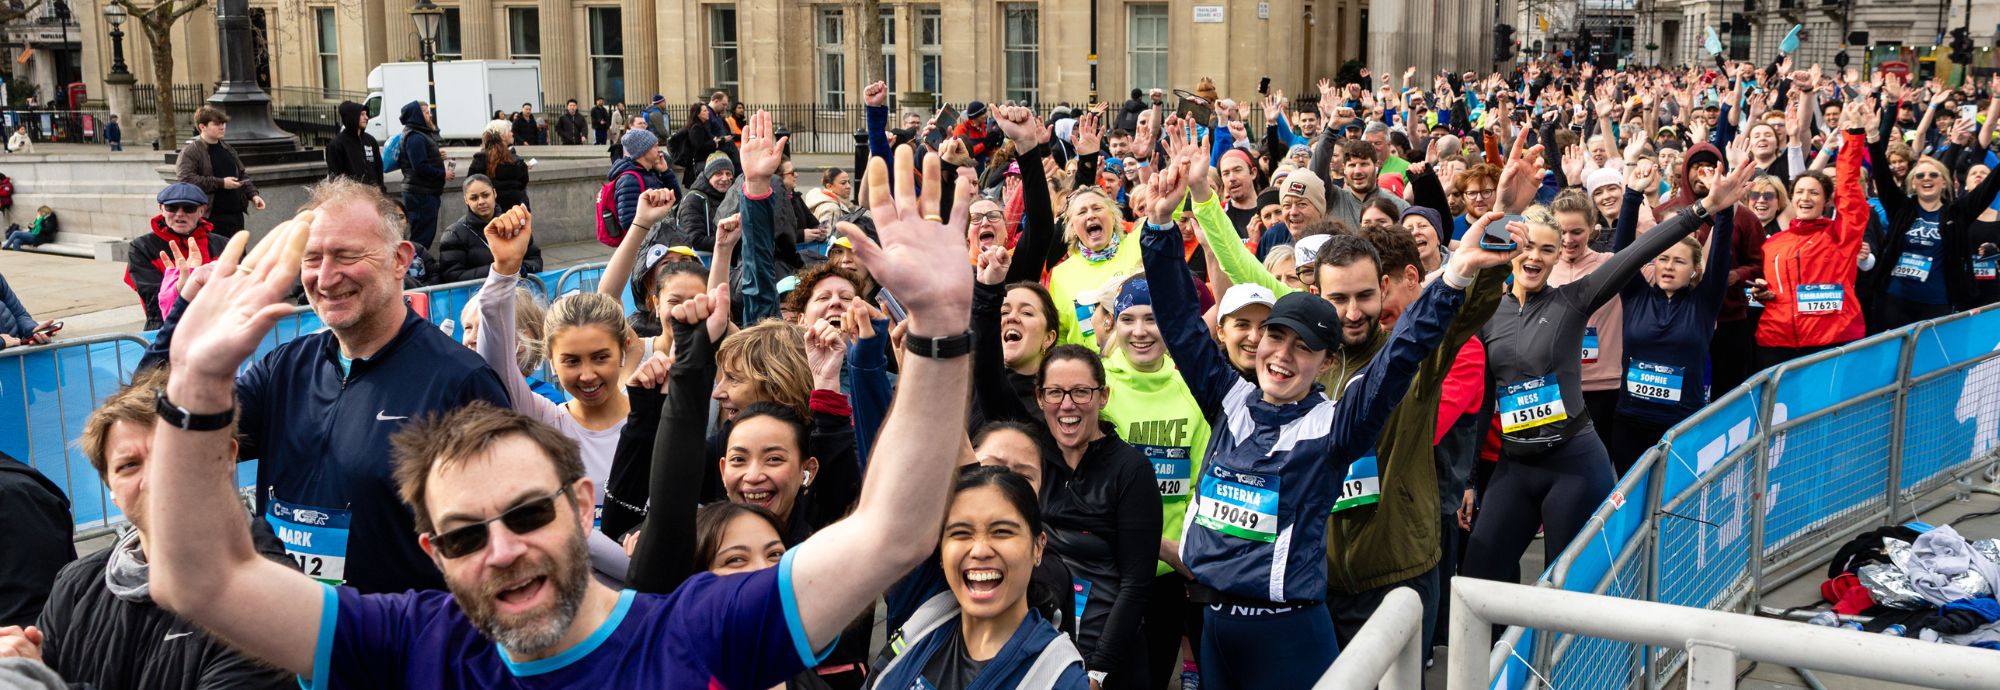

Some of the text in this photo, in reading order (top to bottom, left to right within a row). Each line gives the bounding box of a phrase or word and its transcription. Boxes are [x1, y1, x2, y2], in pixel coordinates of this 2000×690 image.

[1807, 301, 1838, 311] 17628
[1640, 373, 1668, 385] SOPHIE
[1517, 392, 1539, 407] NESS
[1635, 384, 1670, 398] 20288
[1512, 404, 1552, 423] 15166
[1128, 418, 1188, 447] NIKE
[1154, 463, 1175, 475] SABI
[1216, 484, 1262, 507] ESTERKA
[1341, 480, 1362, 498] 19
[1212, 502, 1259, 529] 19049
[278, 526, 312, 548] MARK
